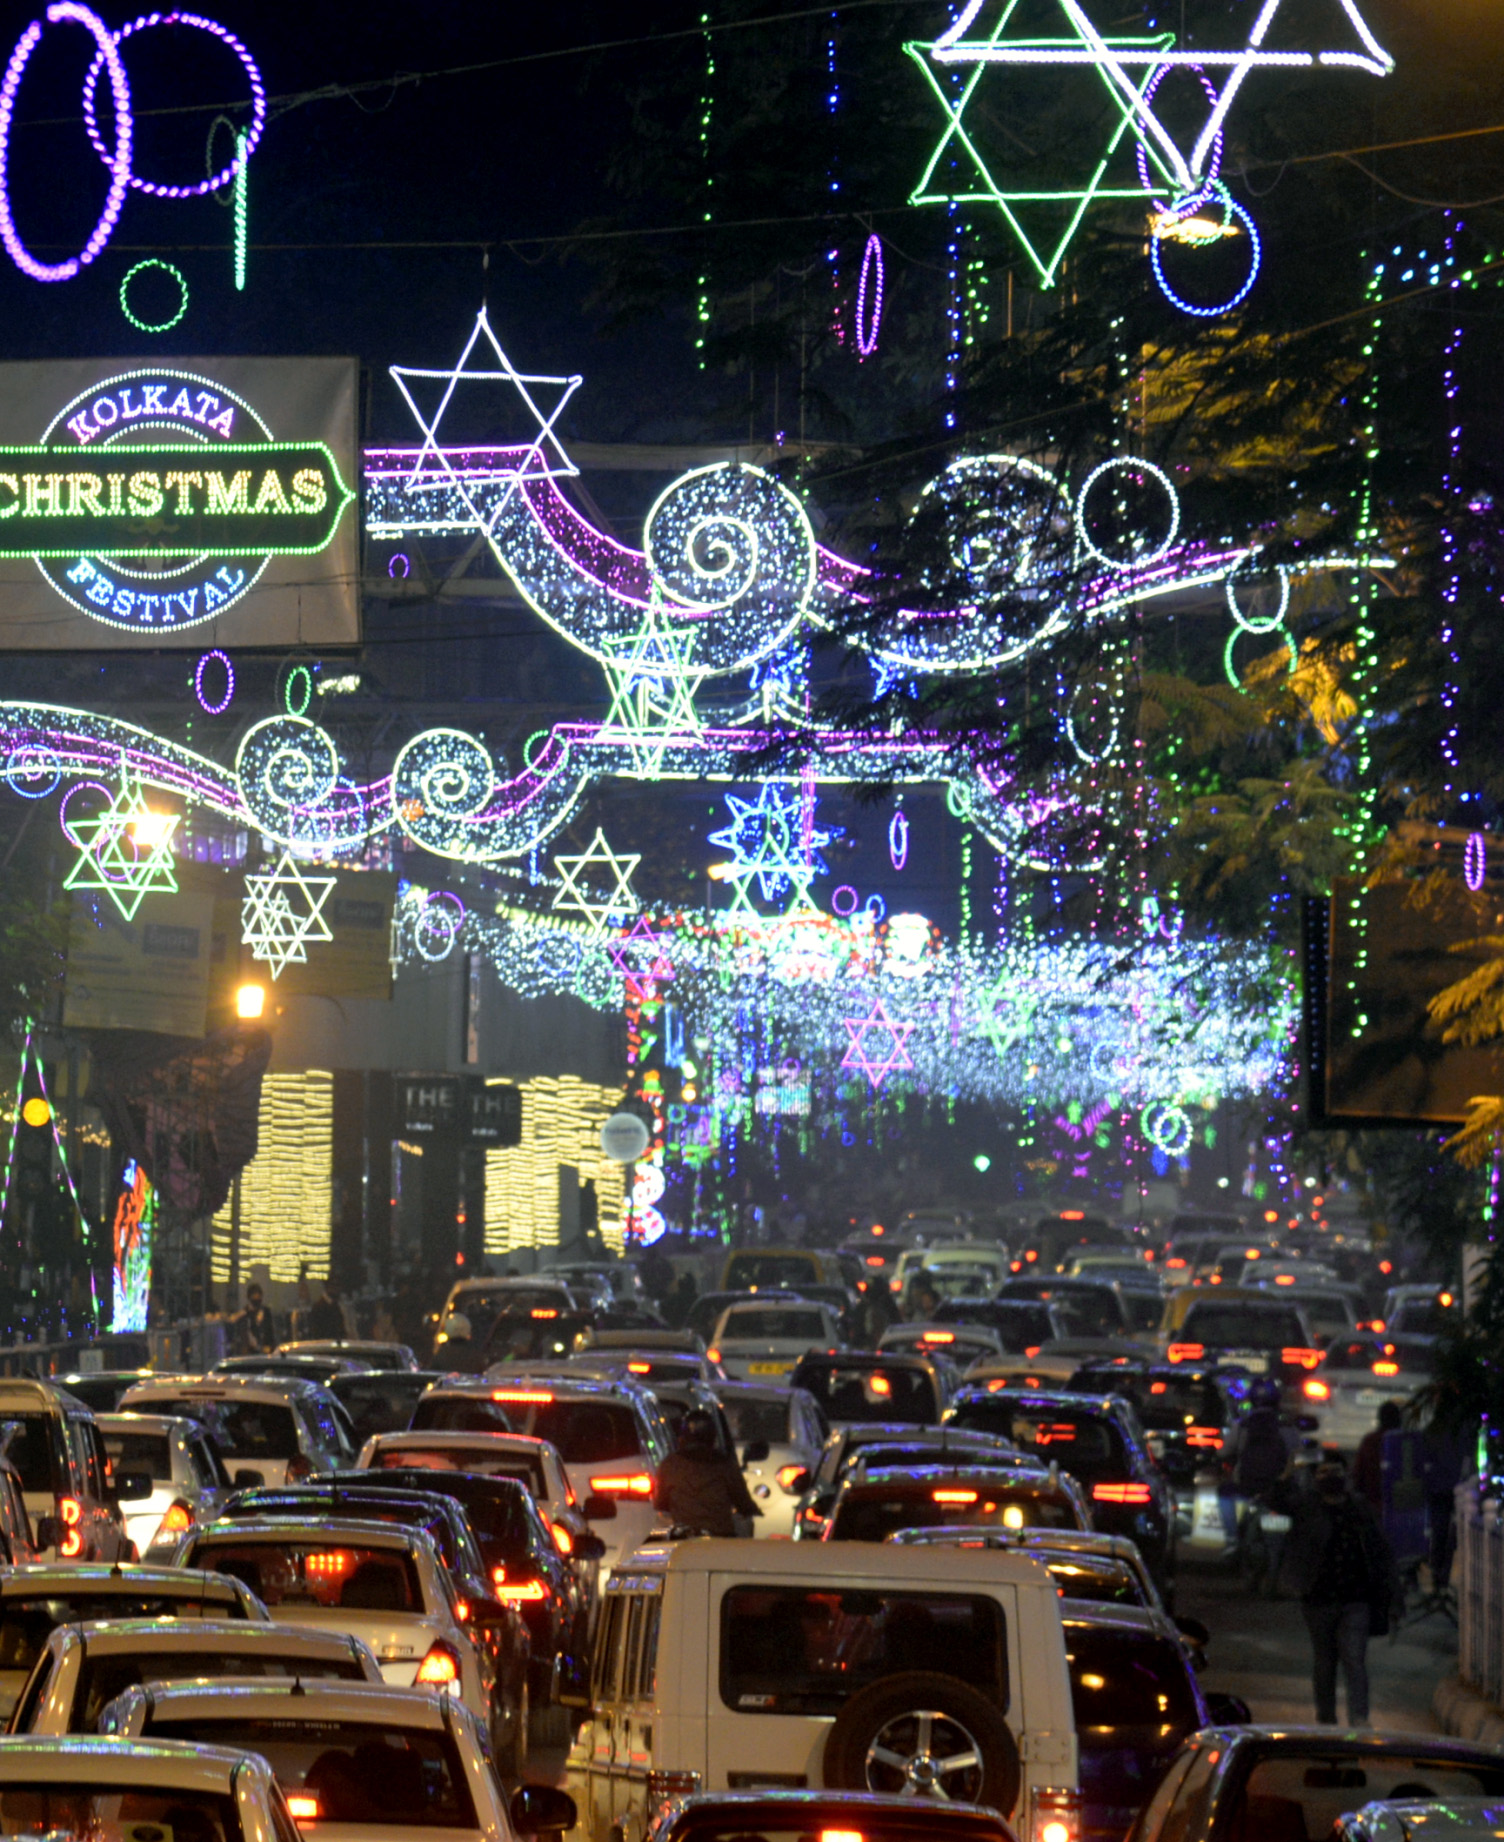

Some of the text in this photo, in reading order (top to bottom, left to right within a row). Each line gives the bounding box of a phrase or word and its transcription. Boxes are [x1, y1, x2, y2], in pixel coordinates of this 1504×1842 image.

[67, 385, 236, 445] KOLKATA
[67, 556, 245, 622] FESTIVAL
[405, 1086, 454, 1107] THE
